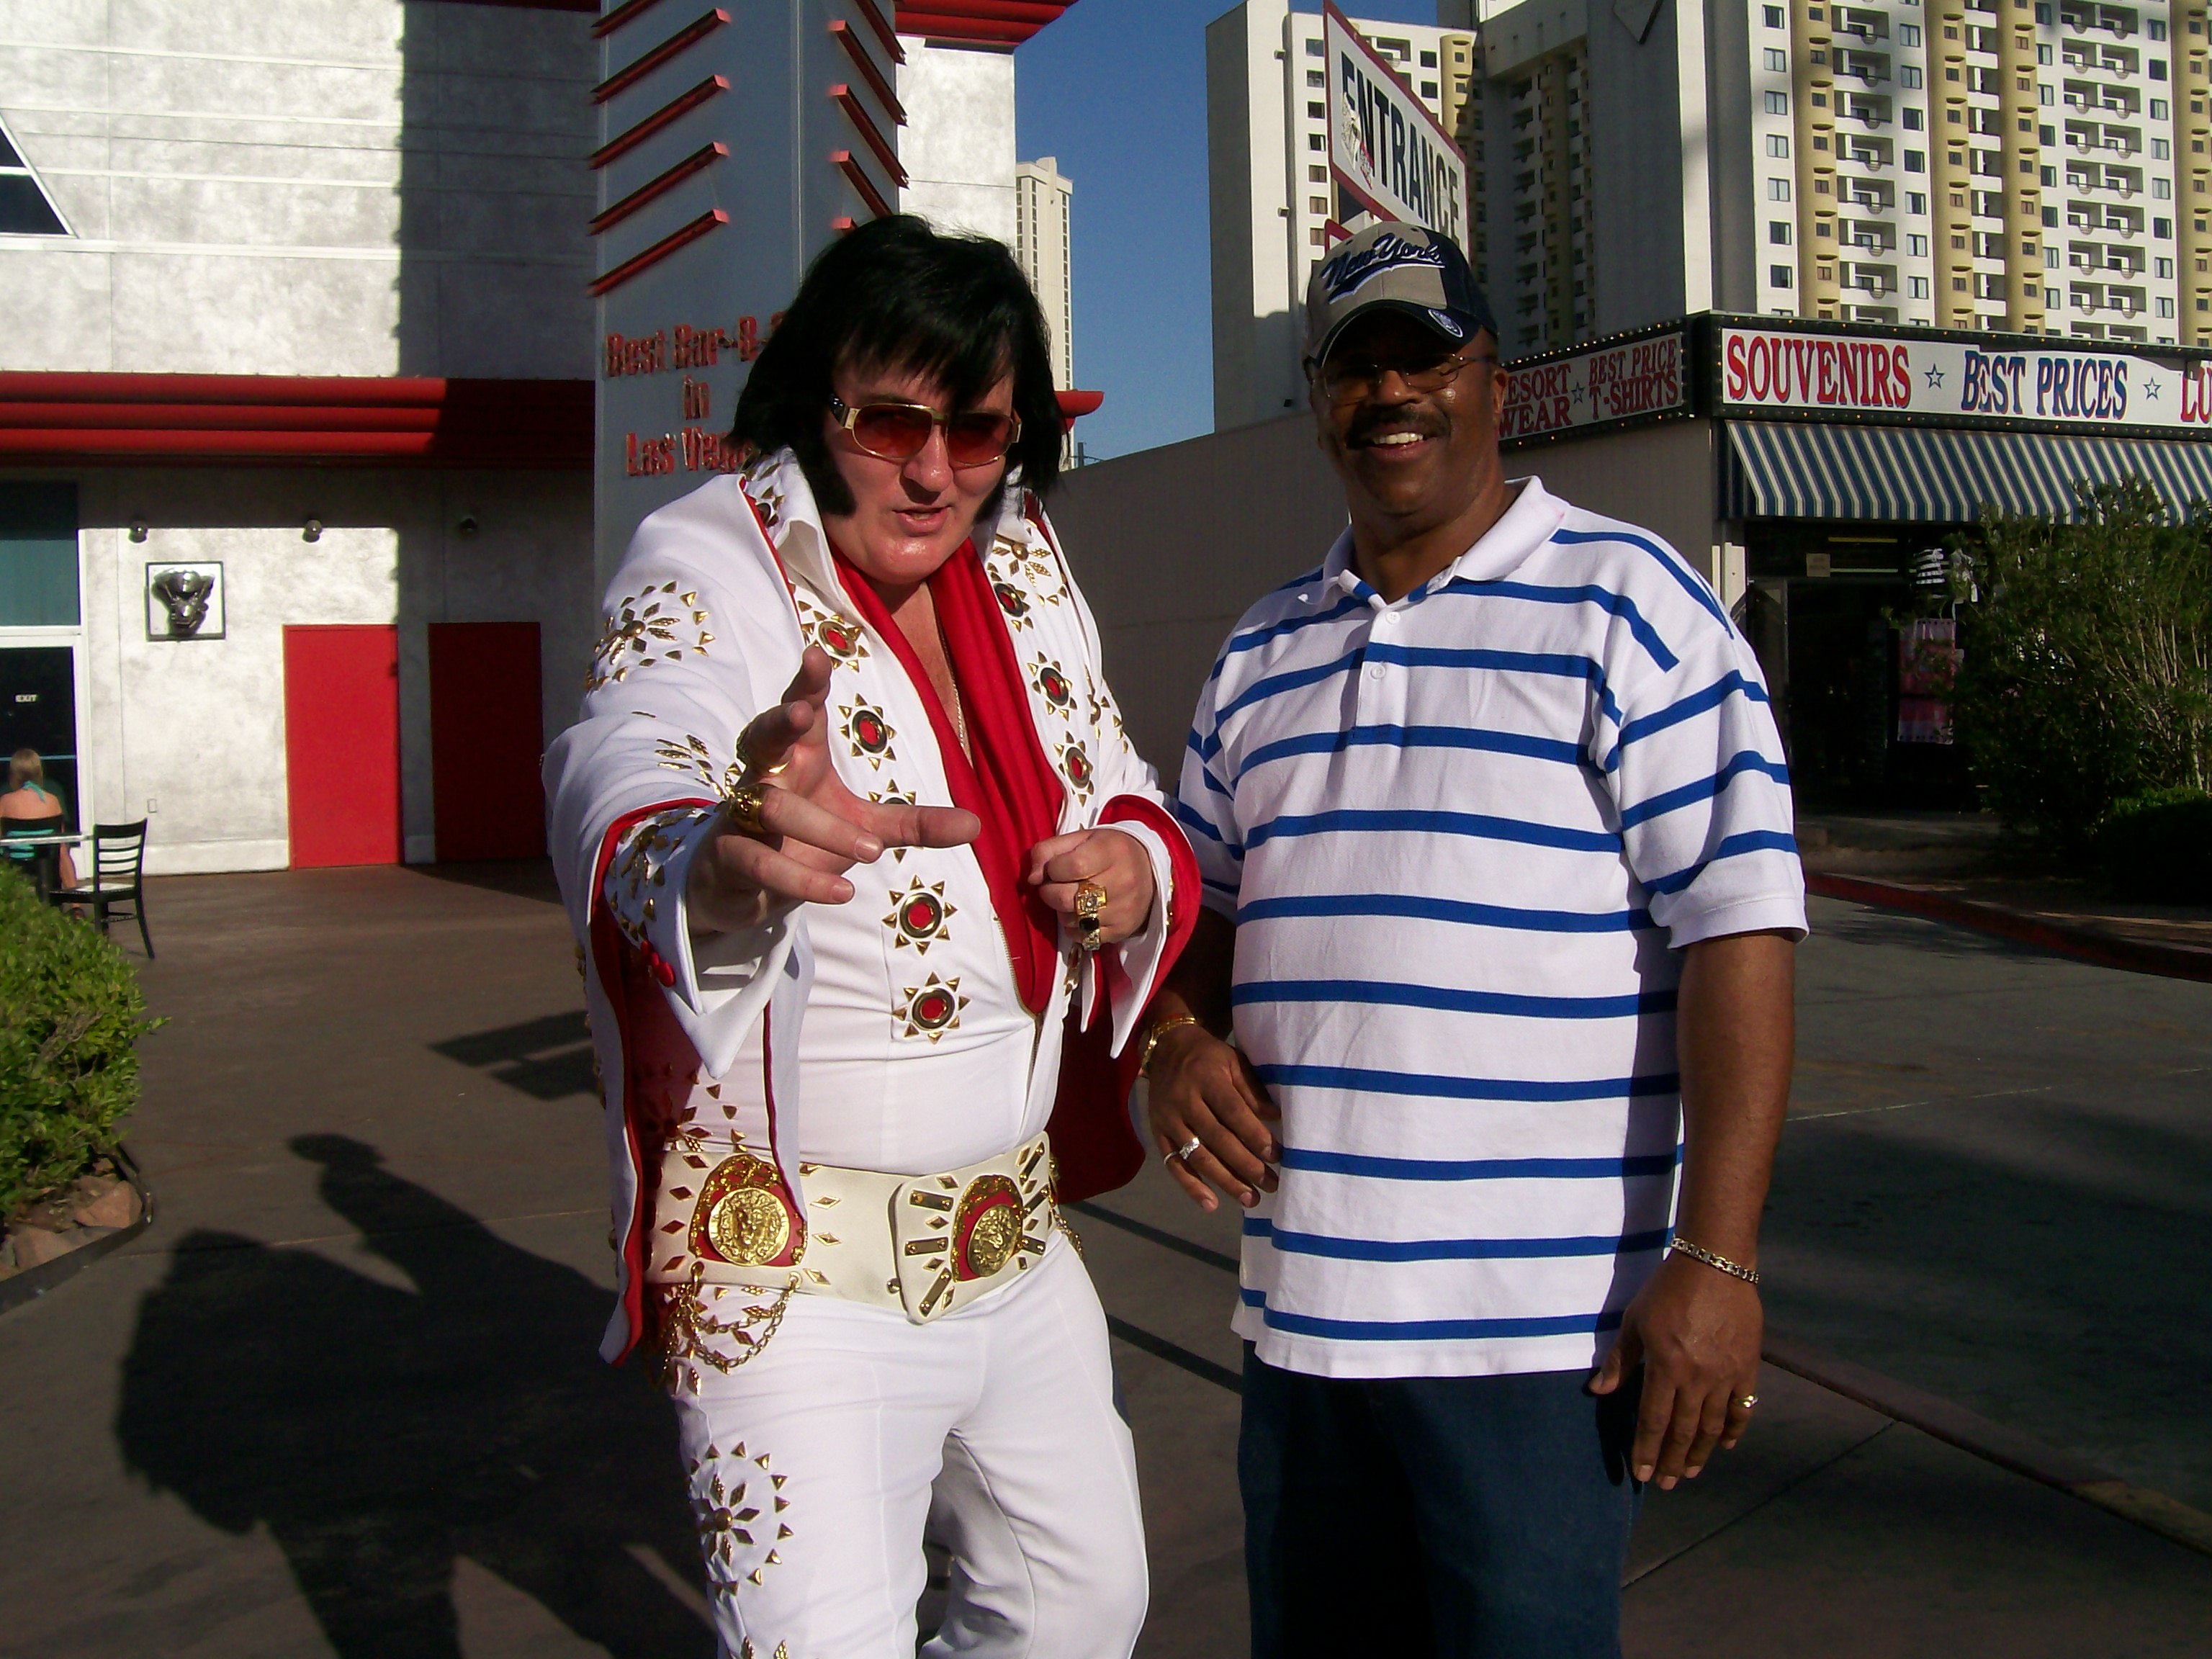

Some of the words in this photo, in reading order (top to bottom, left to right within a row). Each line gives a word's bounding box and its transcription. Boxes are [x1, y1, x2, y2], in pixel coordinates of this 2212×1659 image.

[1341, 50, 1460, 248] ENTRANCE
[1321, 250, 1376, 291] New
[1372, 233, 1442, 264] York
[606, 329, 666, 377] Best
[1589, 351, 1626, 386] BEST
[1631, 338, 1677, 377] PRICE
[1727, 334, 1911, 409] SOUVENIRS
[1961, 350, 2027, 415] BEST
[2036, 357, 2128, 420] PRICES
[683, 374, 710, 420] in
[1503, 364, 1571, 406] ESORT
[1499, 397, 1573, 437] WEAR
[626, 432, 675, 477] Las
[681, 426, 750, 474] Veg
